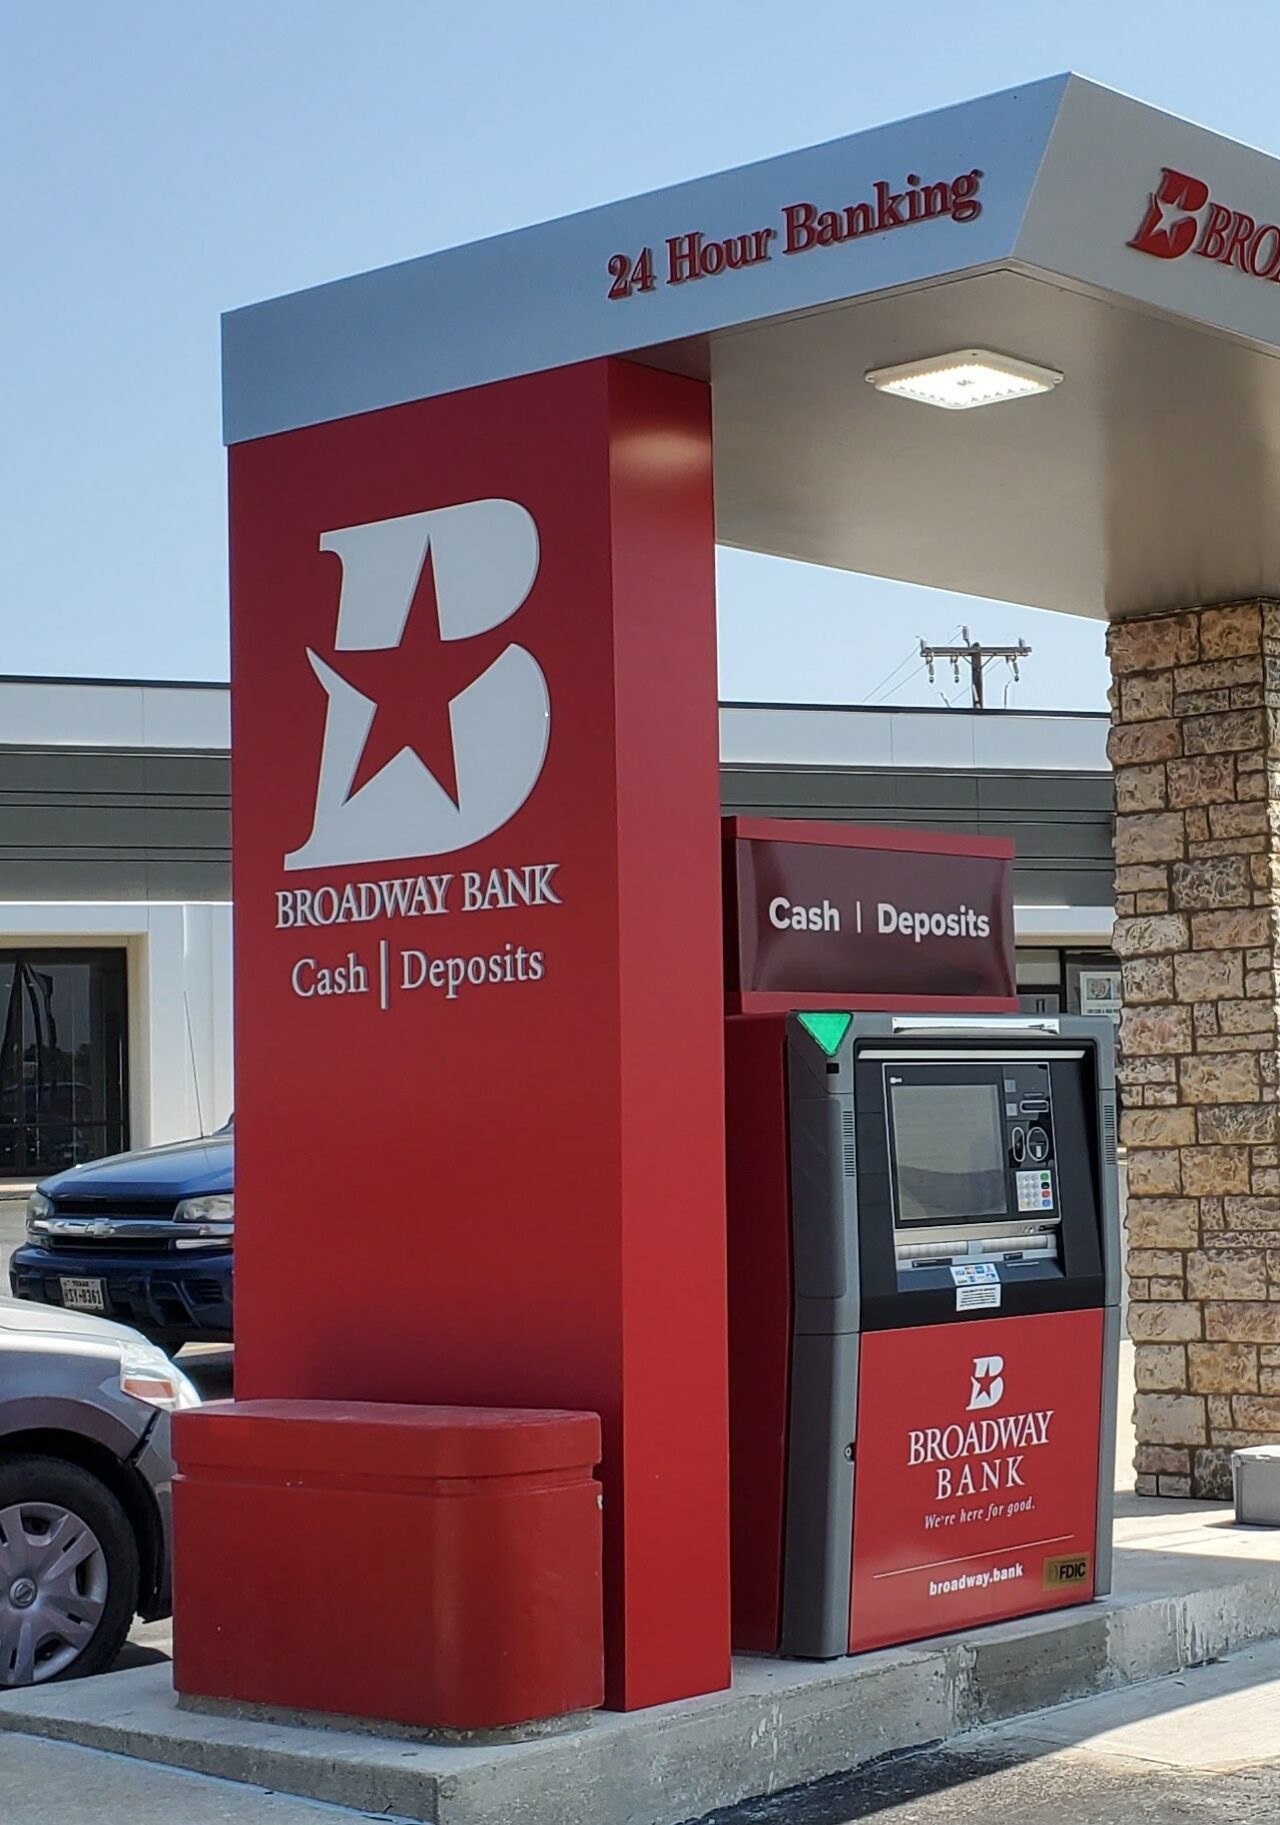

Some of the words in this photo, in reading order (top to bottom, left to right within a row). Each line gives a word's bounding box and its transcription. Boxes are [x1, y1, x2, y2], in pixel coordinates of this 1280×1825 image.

[608, 246, 656, 300] 24
[664, 229, 777, 286] Hour
[780, 167, 984, 256] Banking
[274, 873, 454, 929] BROADWAY
[460, 863, 563, 912] BANK
[768, 897, 841, 932] Cash
[877, 902, 990, 943] Deposits
[291, 952, 370, 997] Cash
[400, 943, 546, 1000] Deposits
[906, 1410, 1055, 1467] BROADWAY
[935, 1455, 1026, 1501] BANK
[924, 1513, 957, 1530] We're
[960, 1507, 984, 1524] here
[986, 1503, 1004, 1521] for
[1006, 1495, 1036, 1518] good.
[928, 1562, 1024, 1597] broadway.bank
[1059, 1562, 1087, 1580] FDIC
